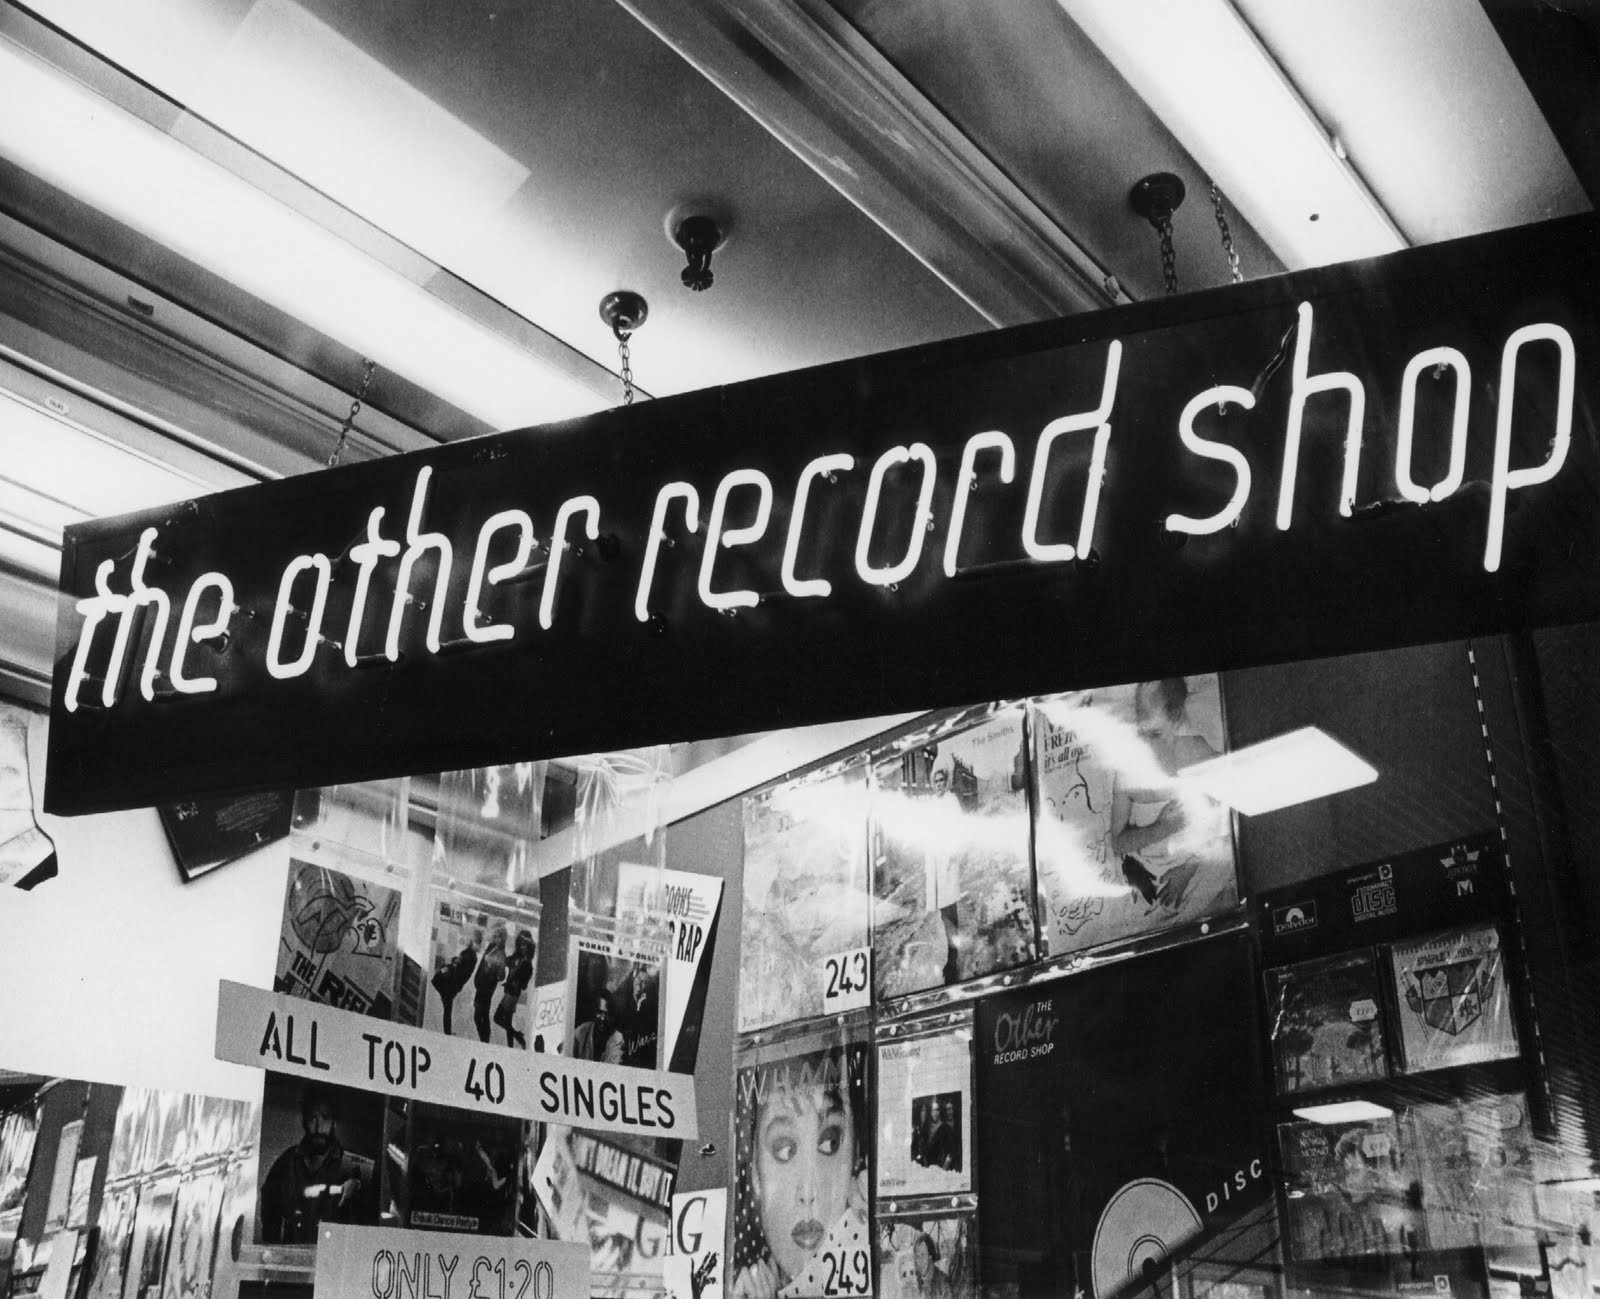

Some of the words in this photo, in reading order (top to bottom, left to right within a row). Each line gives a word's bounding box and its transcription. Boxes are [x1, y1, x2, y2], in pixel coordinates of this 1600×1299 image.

[64, 526, 219, 712] the
[265, 465, 601, 679] other
[634, 339, 1123, 622] record
[1165, 301, 1577, 572] shop
[677, 922, 703, 963] RAP
[994, 1004, 1060, 1052] Other
[1037, 1000, 1053, 1012] THE
[259, 1010, 331, 1072] ALL
[361, 1032, 431, 1089] TOP
[464, 1058, 505, 1104] 40
[540, 1071, 675, 1129] SINGLES
[994, 1049, 1028, 1065] RECORD
[1031, 1043, 1055, 1058] SHOP
[1206, 1159, 1262, 1213] DISC
[372, 1250, 459, 1299] ONLY
[823, 1250, 869, 1296] 249
